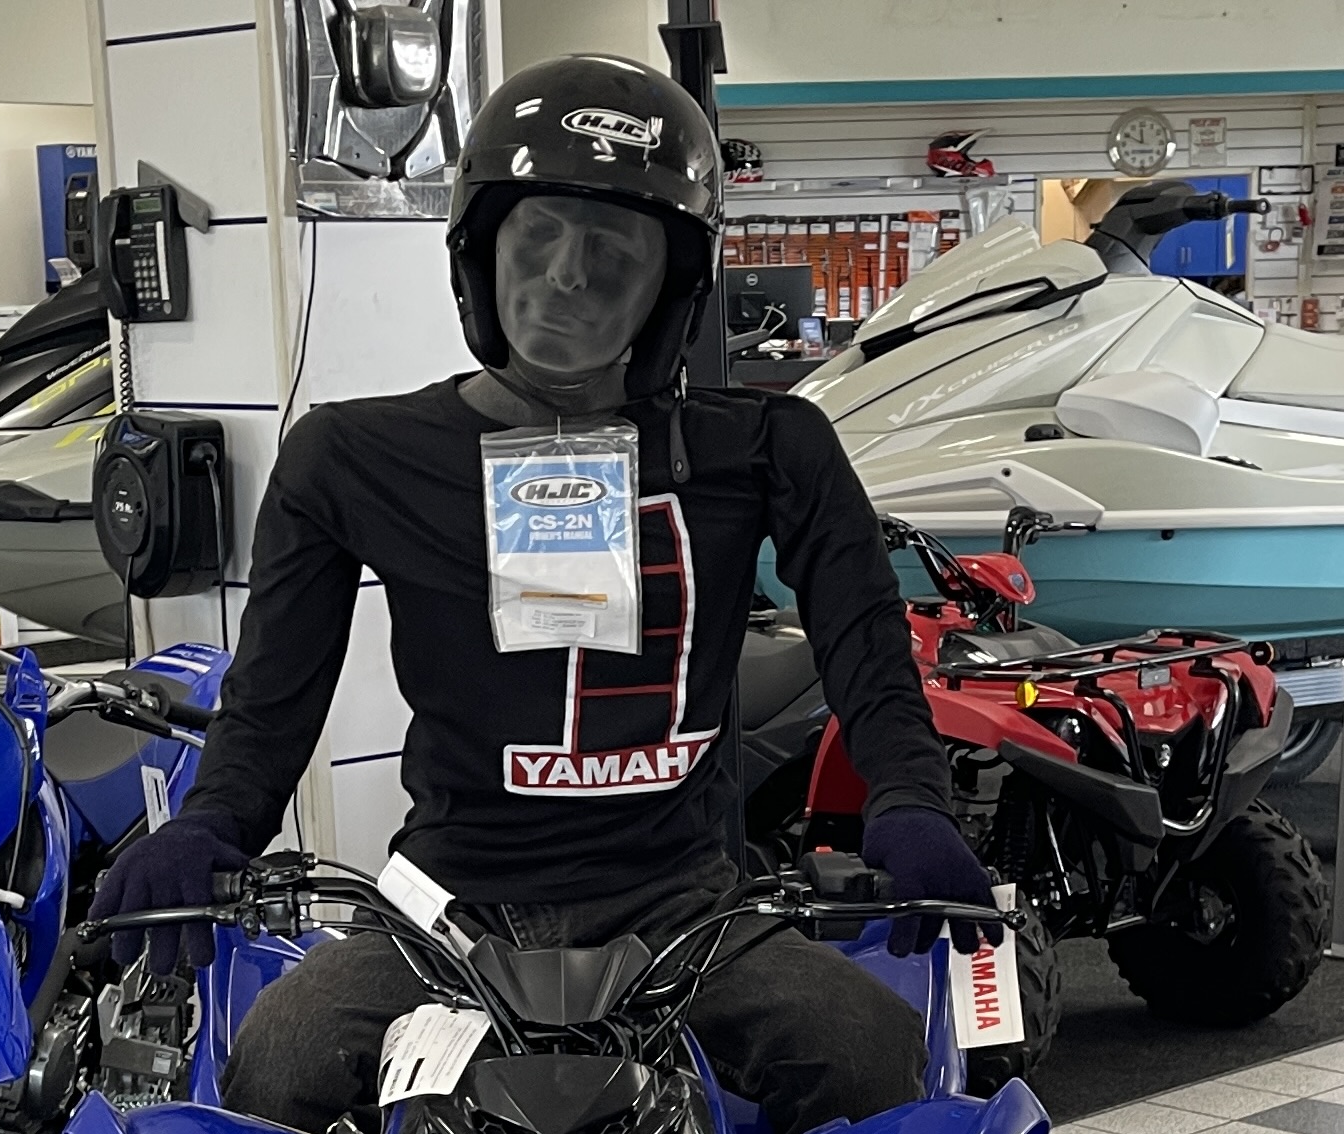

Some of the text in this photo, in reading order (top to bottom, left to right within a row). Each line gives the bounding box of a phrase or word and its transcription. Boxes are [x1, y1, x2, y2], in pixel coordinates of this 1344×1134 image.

[577, 114, 647, 139] HJC
[525, 482, 593, 500] HJC
[528, 513, 593, 531] CS-2N
[971, 937, 1001, 1030] AMAHA
